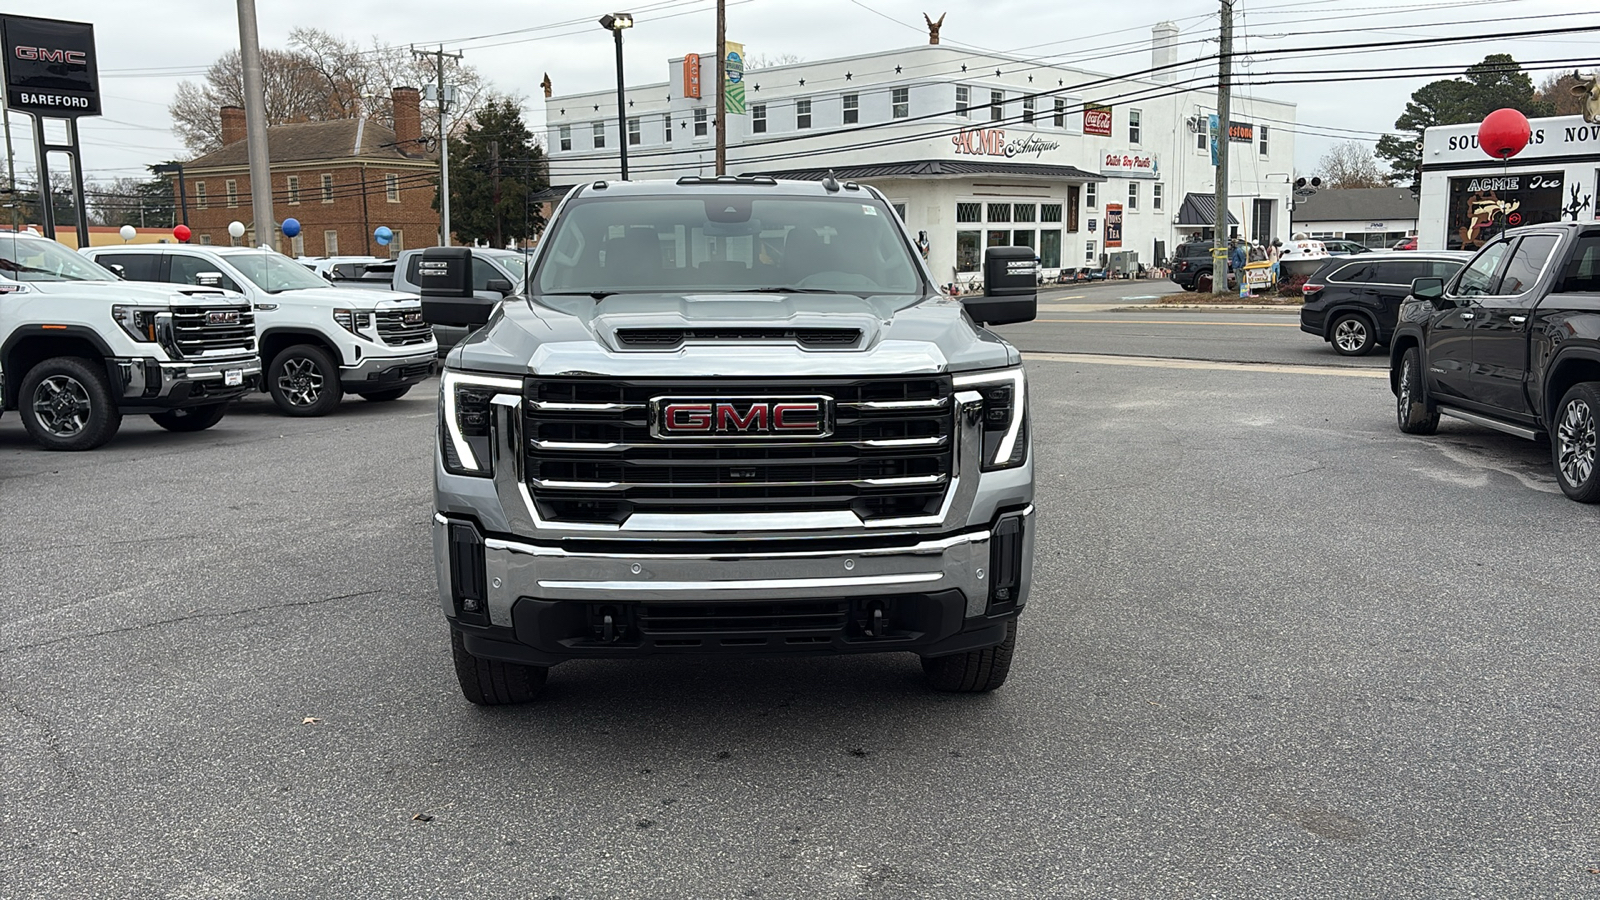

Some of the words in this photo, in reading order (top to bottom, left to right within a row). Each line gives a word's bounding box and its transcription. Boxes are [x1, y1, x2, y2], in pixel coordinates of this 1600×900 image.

[15, 46, 87, 65] GMC
[20, 93, 89, 108] BAREFORD
[1229, 125, 1253, 139] estone
[951, 128, 1005, 156] ACME
[1106, 154, 1120, 166] Dutch
[1122, 155, 1133, 169] Boy
[1133, 156, 1150, 168] Paints
[1467, 177, 1519, 192] ACME
[1529, 175, 1561, 189] Ice
[1108, 228, 1120, 239] TEA
[666, 403, 819, 431] GMC
